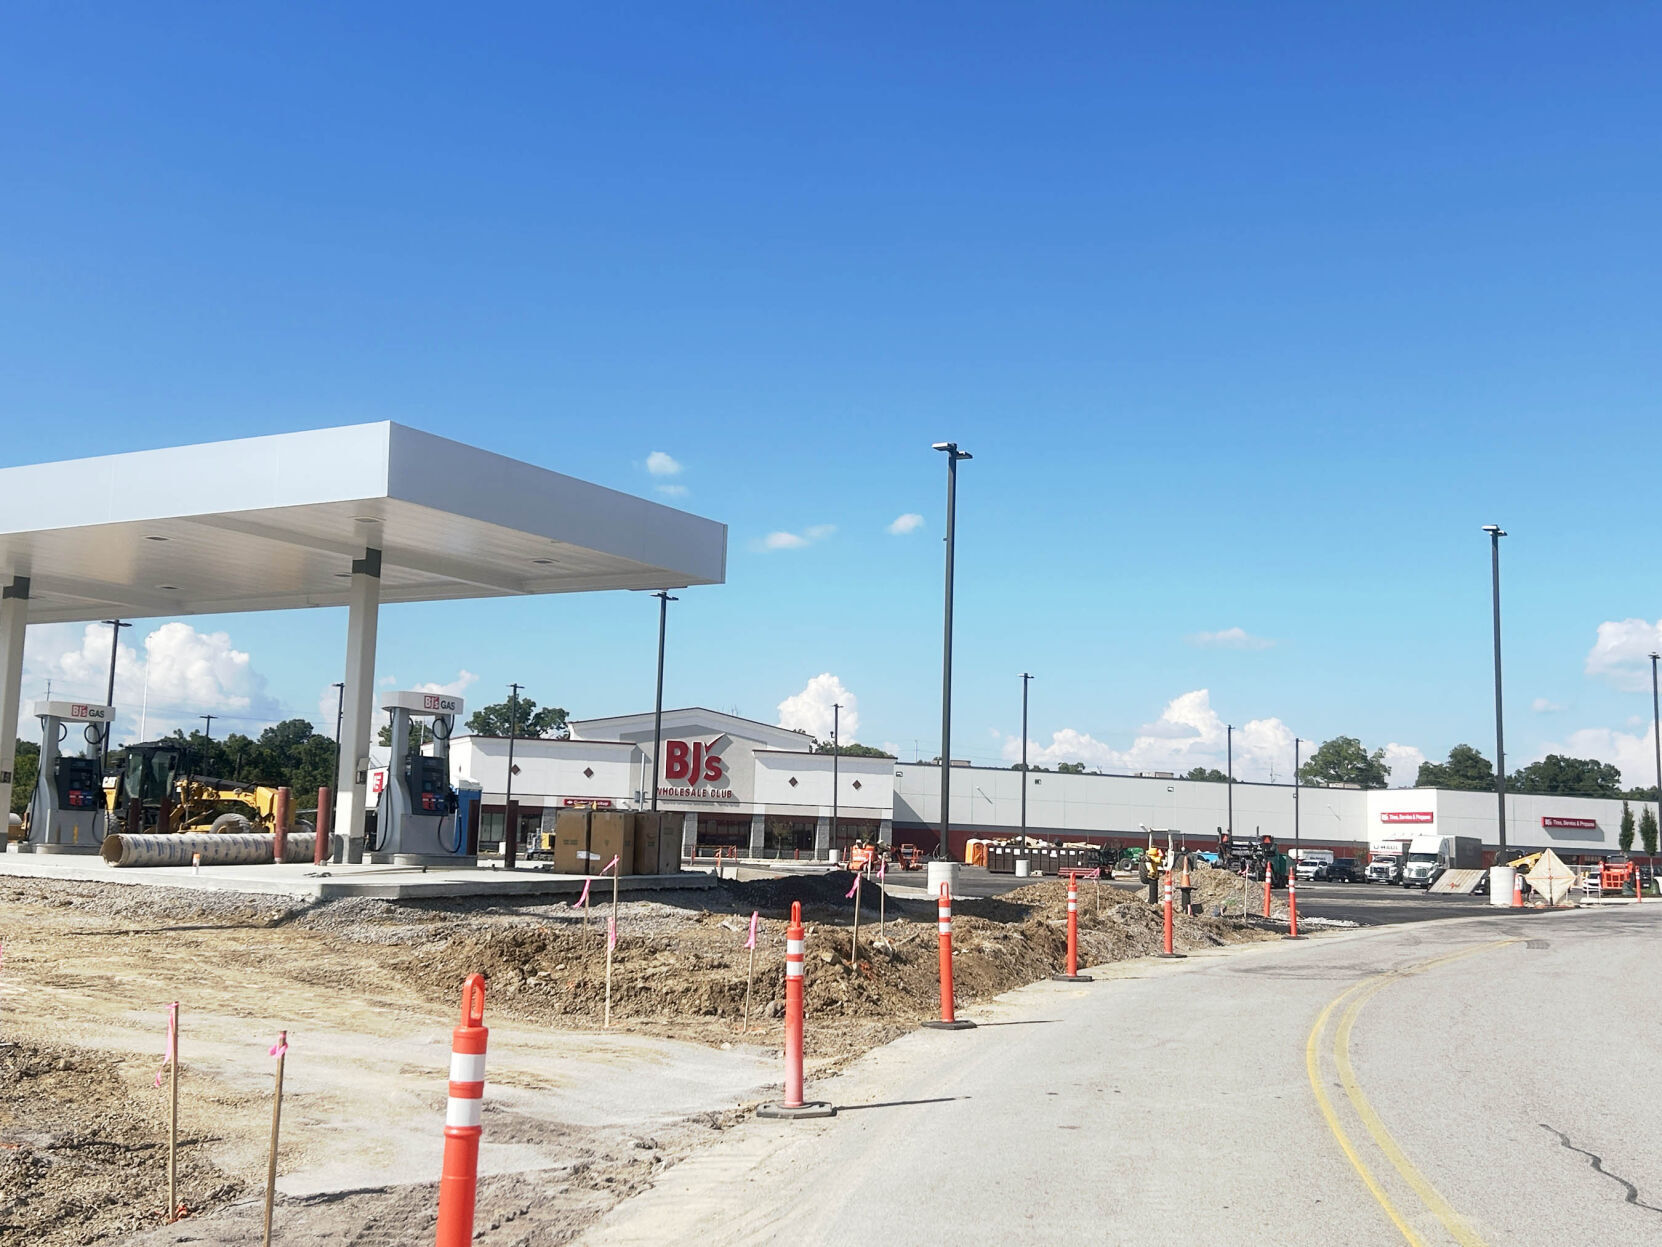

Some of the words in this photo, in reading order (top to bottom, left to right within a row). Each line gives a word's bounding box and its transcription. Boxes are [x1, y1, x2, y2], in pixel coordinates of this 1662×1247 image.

[440, 700, 456, 711] GAS
[88, 709, 105, 719] GAS
[665, 733, 726, 787] BJ's
[657, 786, 707, 798] WHOLESALE
[710, 789, 732, 799] CLUB
